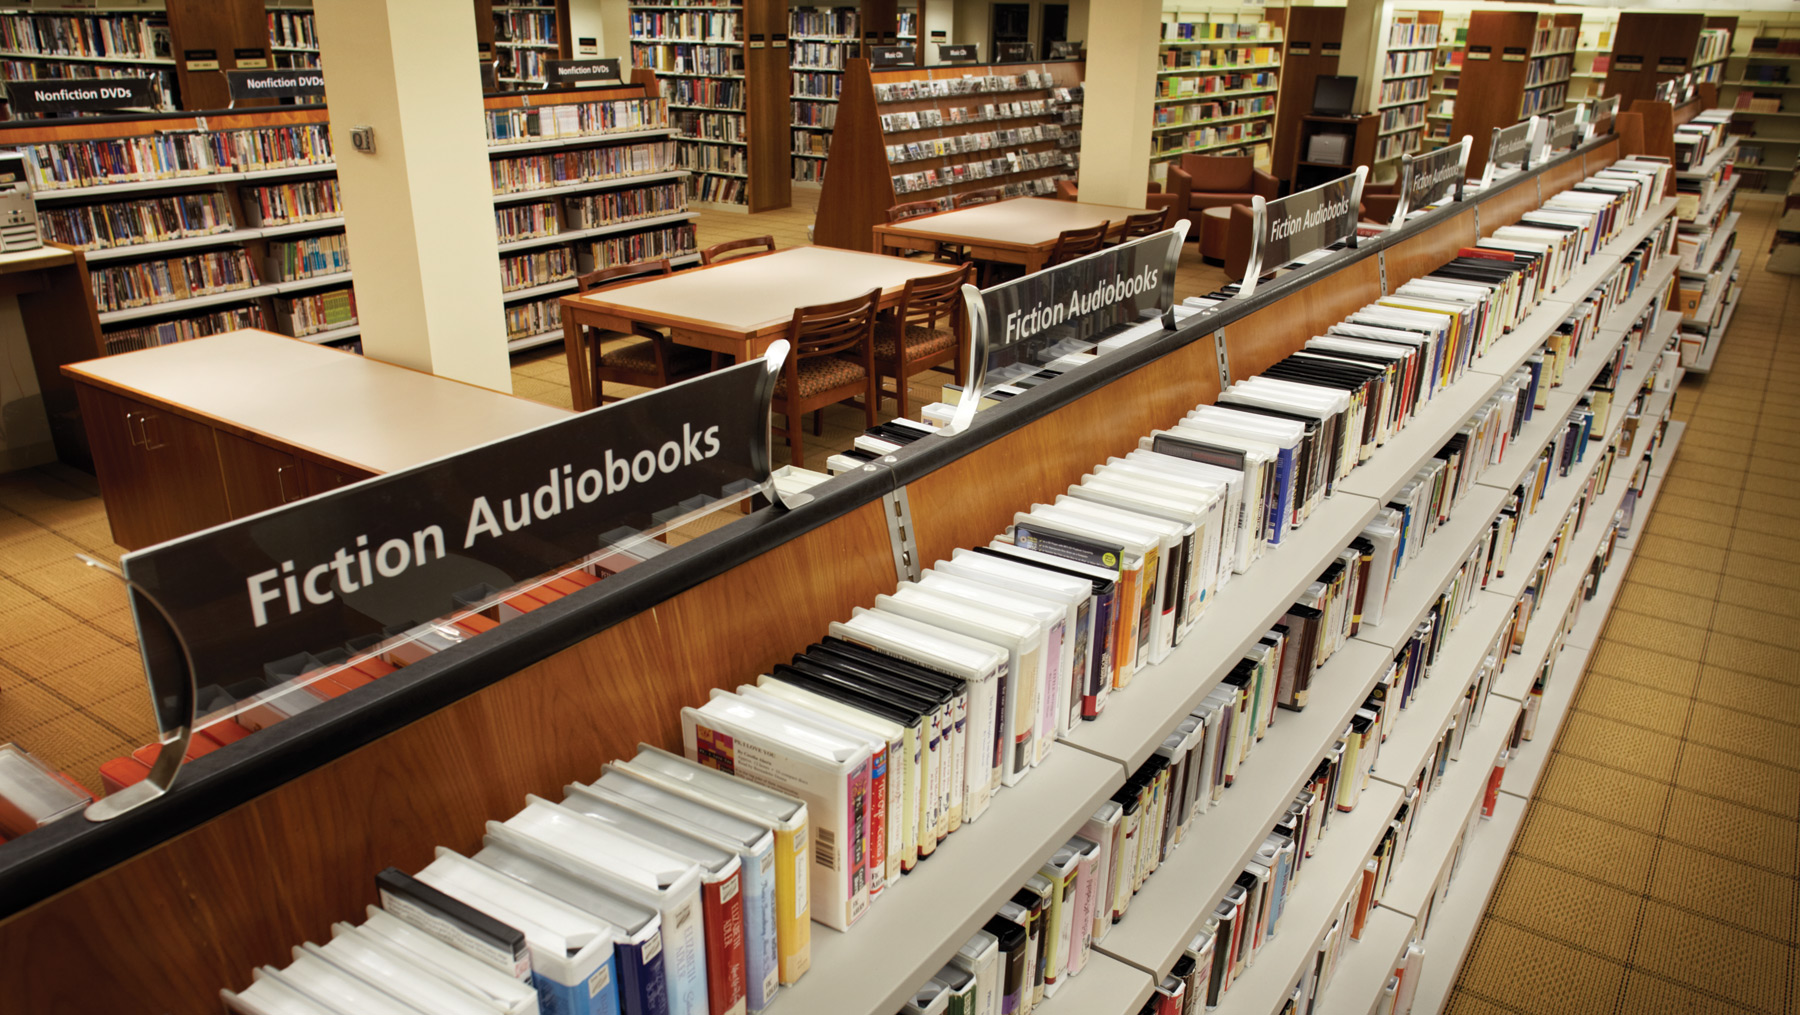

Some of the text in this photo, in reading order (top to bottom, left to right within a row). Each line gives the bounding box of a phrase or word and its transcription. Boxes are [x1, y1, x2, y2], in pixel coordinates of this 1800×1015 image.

[247, 76, 325, 89] Nonfiction DVDs
[558, 65, 609, 75] Nonfiction DVDs
[34, 87, 132, 102] Nonfiction DVDs
[1270, 195, 1350, 242] Fiction Audiobooks
[1005, 264, 1158, 344] Fiction Audiobooks
[247, 422, 720, 627] Fiction Audiobooks
[723, 918, 733, 949] ADLER
[731, 901, 741, 950] ELIZABETH
[676, 945, 687, 978] ADLER
[684, 925, 697, 984] ELIZABETH
